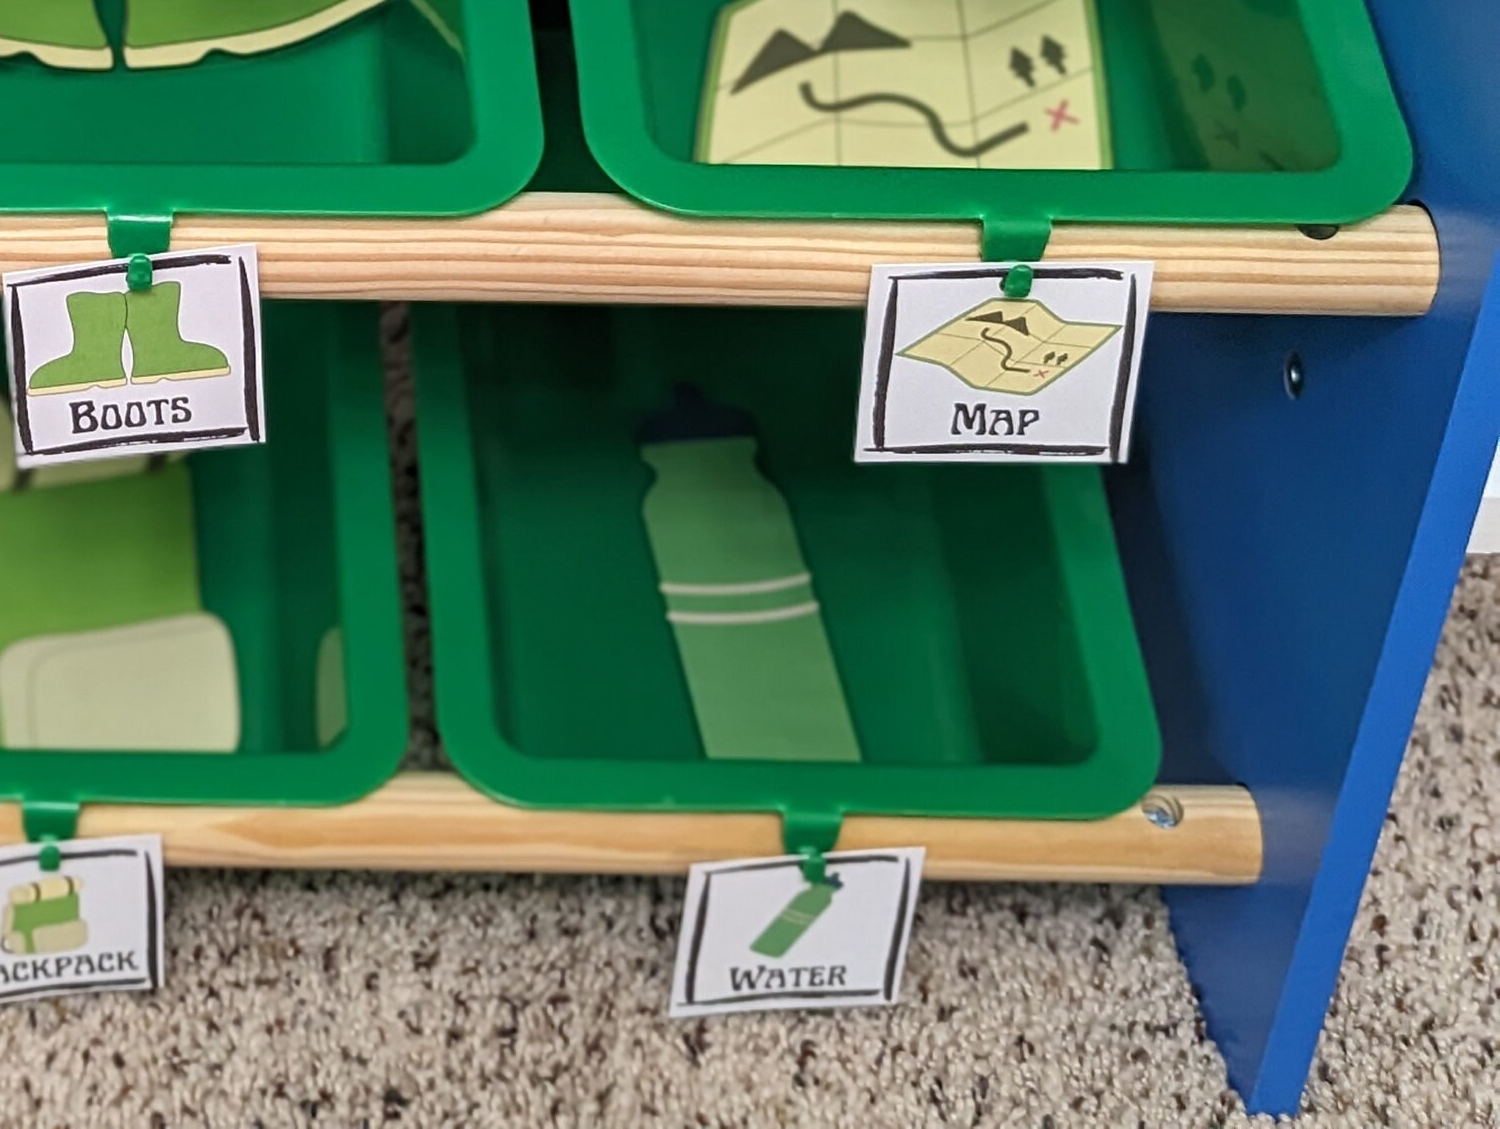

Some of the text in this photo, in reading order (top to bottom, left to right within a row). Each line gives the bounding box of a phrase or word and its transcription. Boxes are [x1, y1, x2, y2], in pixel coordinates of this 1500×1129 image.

[69, 396, 192, 434] BOOTS
[950, 402, 1041, 436] MAP
[729, 965, 848, 992] WATER
